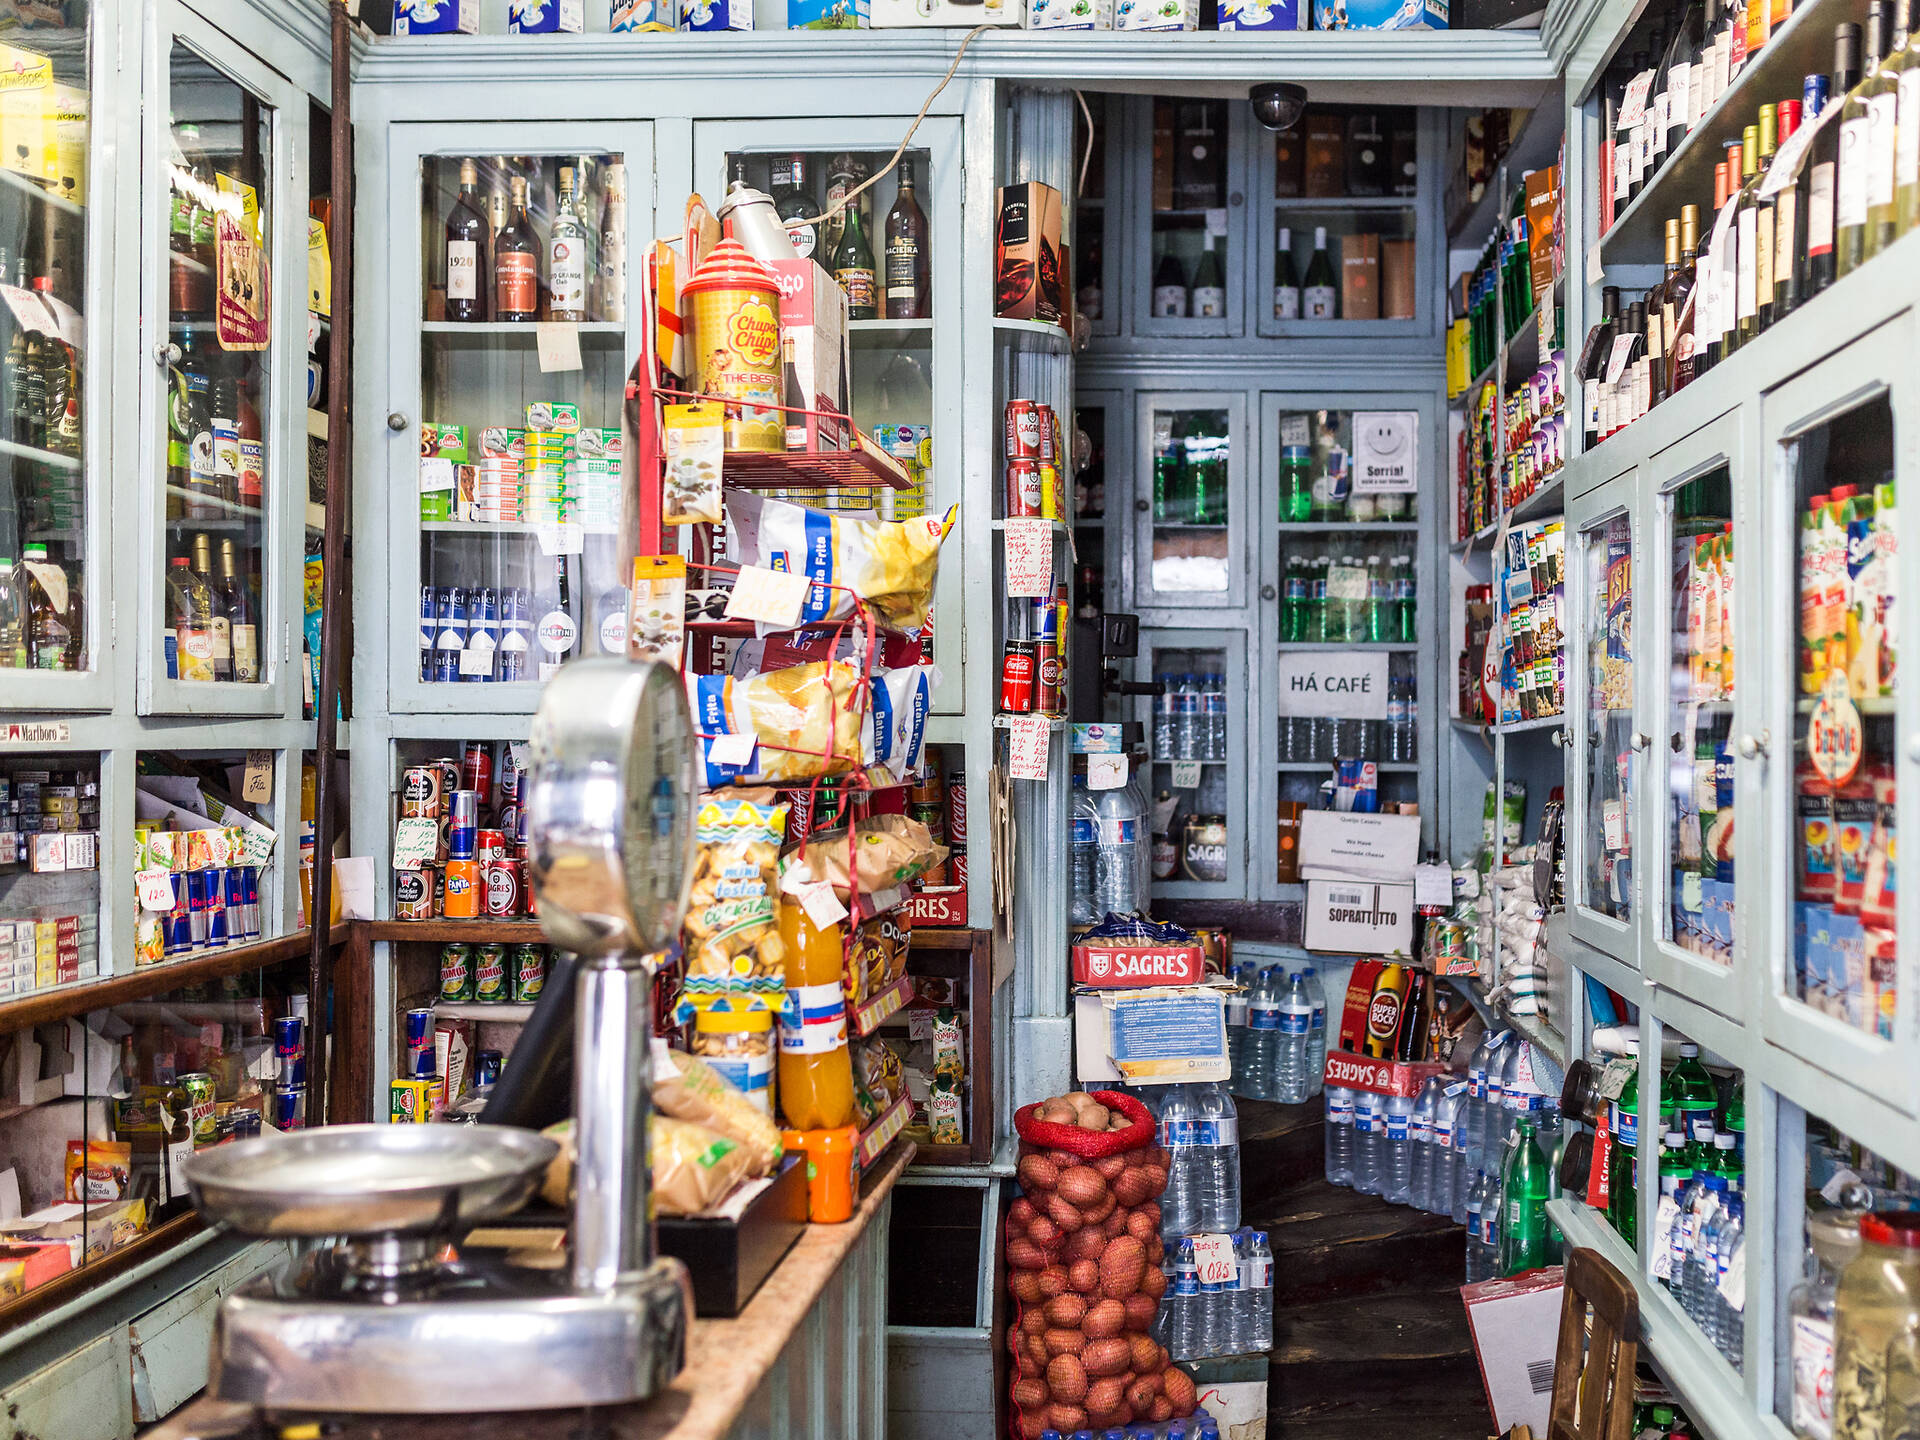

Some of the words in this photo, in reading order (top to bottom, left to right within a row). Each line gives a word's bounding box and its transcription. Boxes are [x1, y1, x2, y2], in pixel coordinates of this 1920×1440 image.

[449, 256, 473, 267] 1920
[737, 315, 776, 336] Chupa
[735, 331, 776, 357] Chups
[723, 373, 749, 384] THE
[750, 373, 776, 385] BEST
[814, 536, 827, 566] Frita
[540, 628, 573, 638] MARTINI
[1291, 672, 1318, 692] HÁ
[1324, 673, 1371, 693] CAFÉ
[707, 694, 720, 725] Frita
[21, 724, 57, 742] Marlboro
[874, 711, 885, 747] Batata
[724, 866, 760, 879] mini
[448, 879, 470, 890] FANTA
[715, 882, 766, 898] tostas
[907, 897, 950, 919] GRES
[1329, 906, 1397, 927] SOPRATTUTTO
[1114, 953, 1189, 977] SAGRES
[1371, 1003, 1397, 1018] SUPER
[1371, 1013, 1395, 1027] BOCK
[1326, 1058, 1375, 1085] SAGRES
[90, 1181, 103, 1189] Noz
